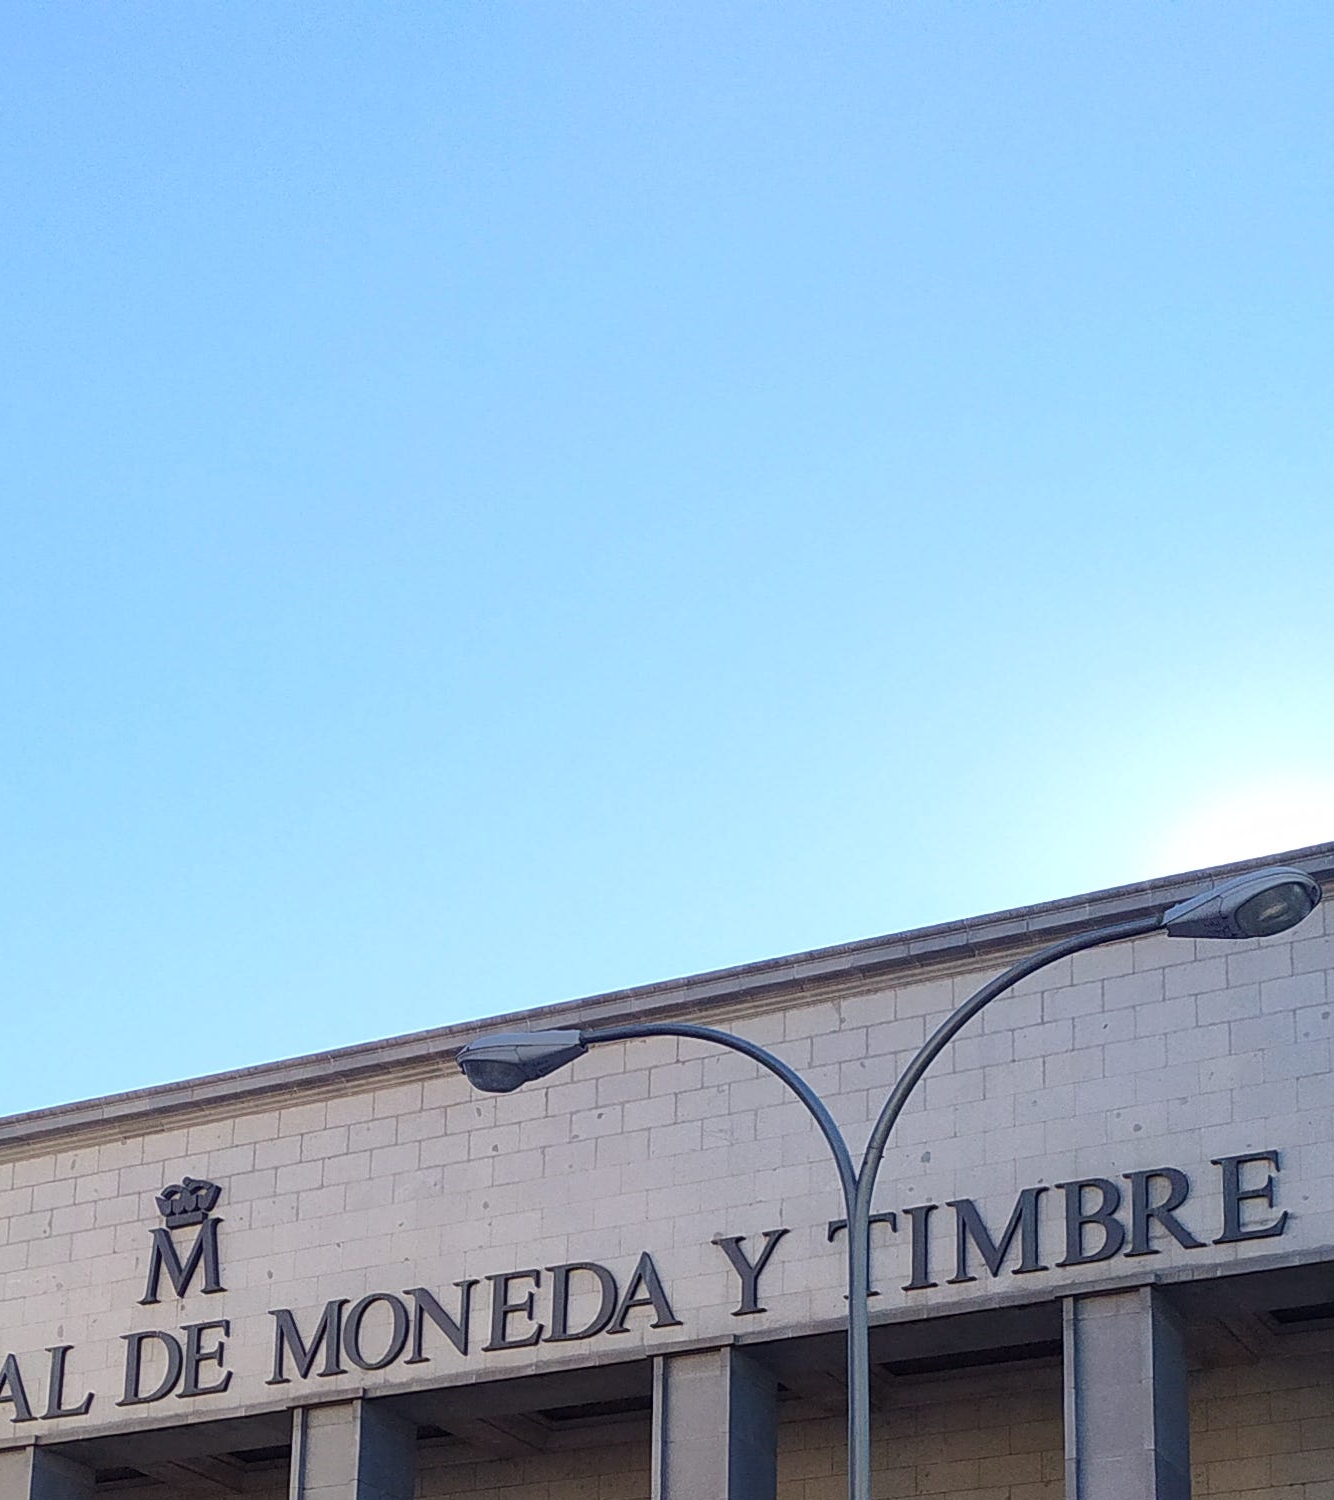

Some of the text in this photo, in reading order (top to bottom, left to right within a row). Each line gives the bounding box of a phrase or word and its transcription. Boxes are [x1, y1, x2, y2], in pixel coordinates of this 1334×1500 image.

[115, 1318, 234, 1408] DE
[266, 1250, 682, 1386] MONEDA
[711, 1227, 790, 1316] Y
[827, 1149, 1290, 1301] TIMBRE
